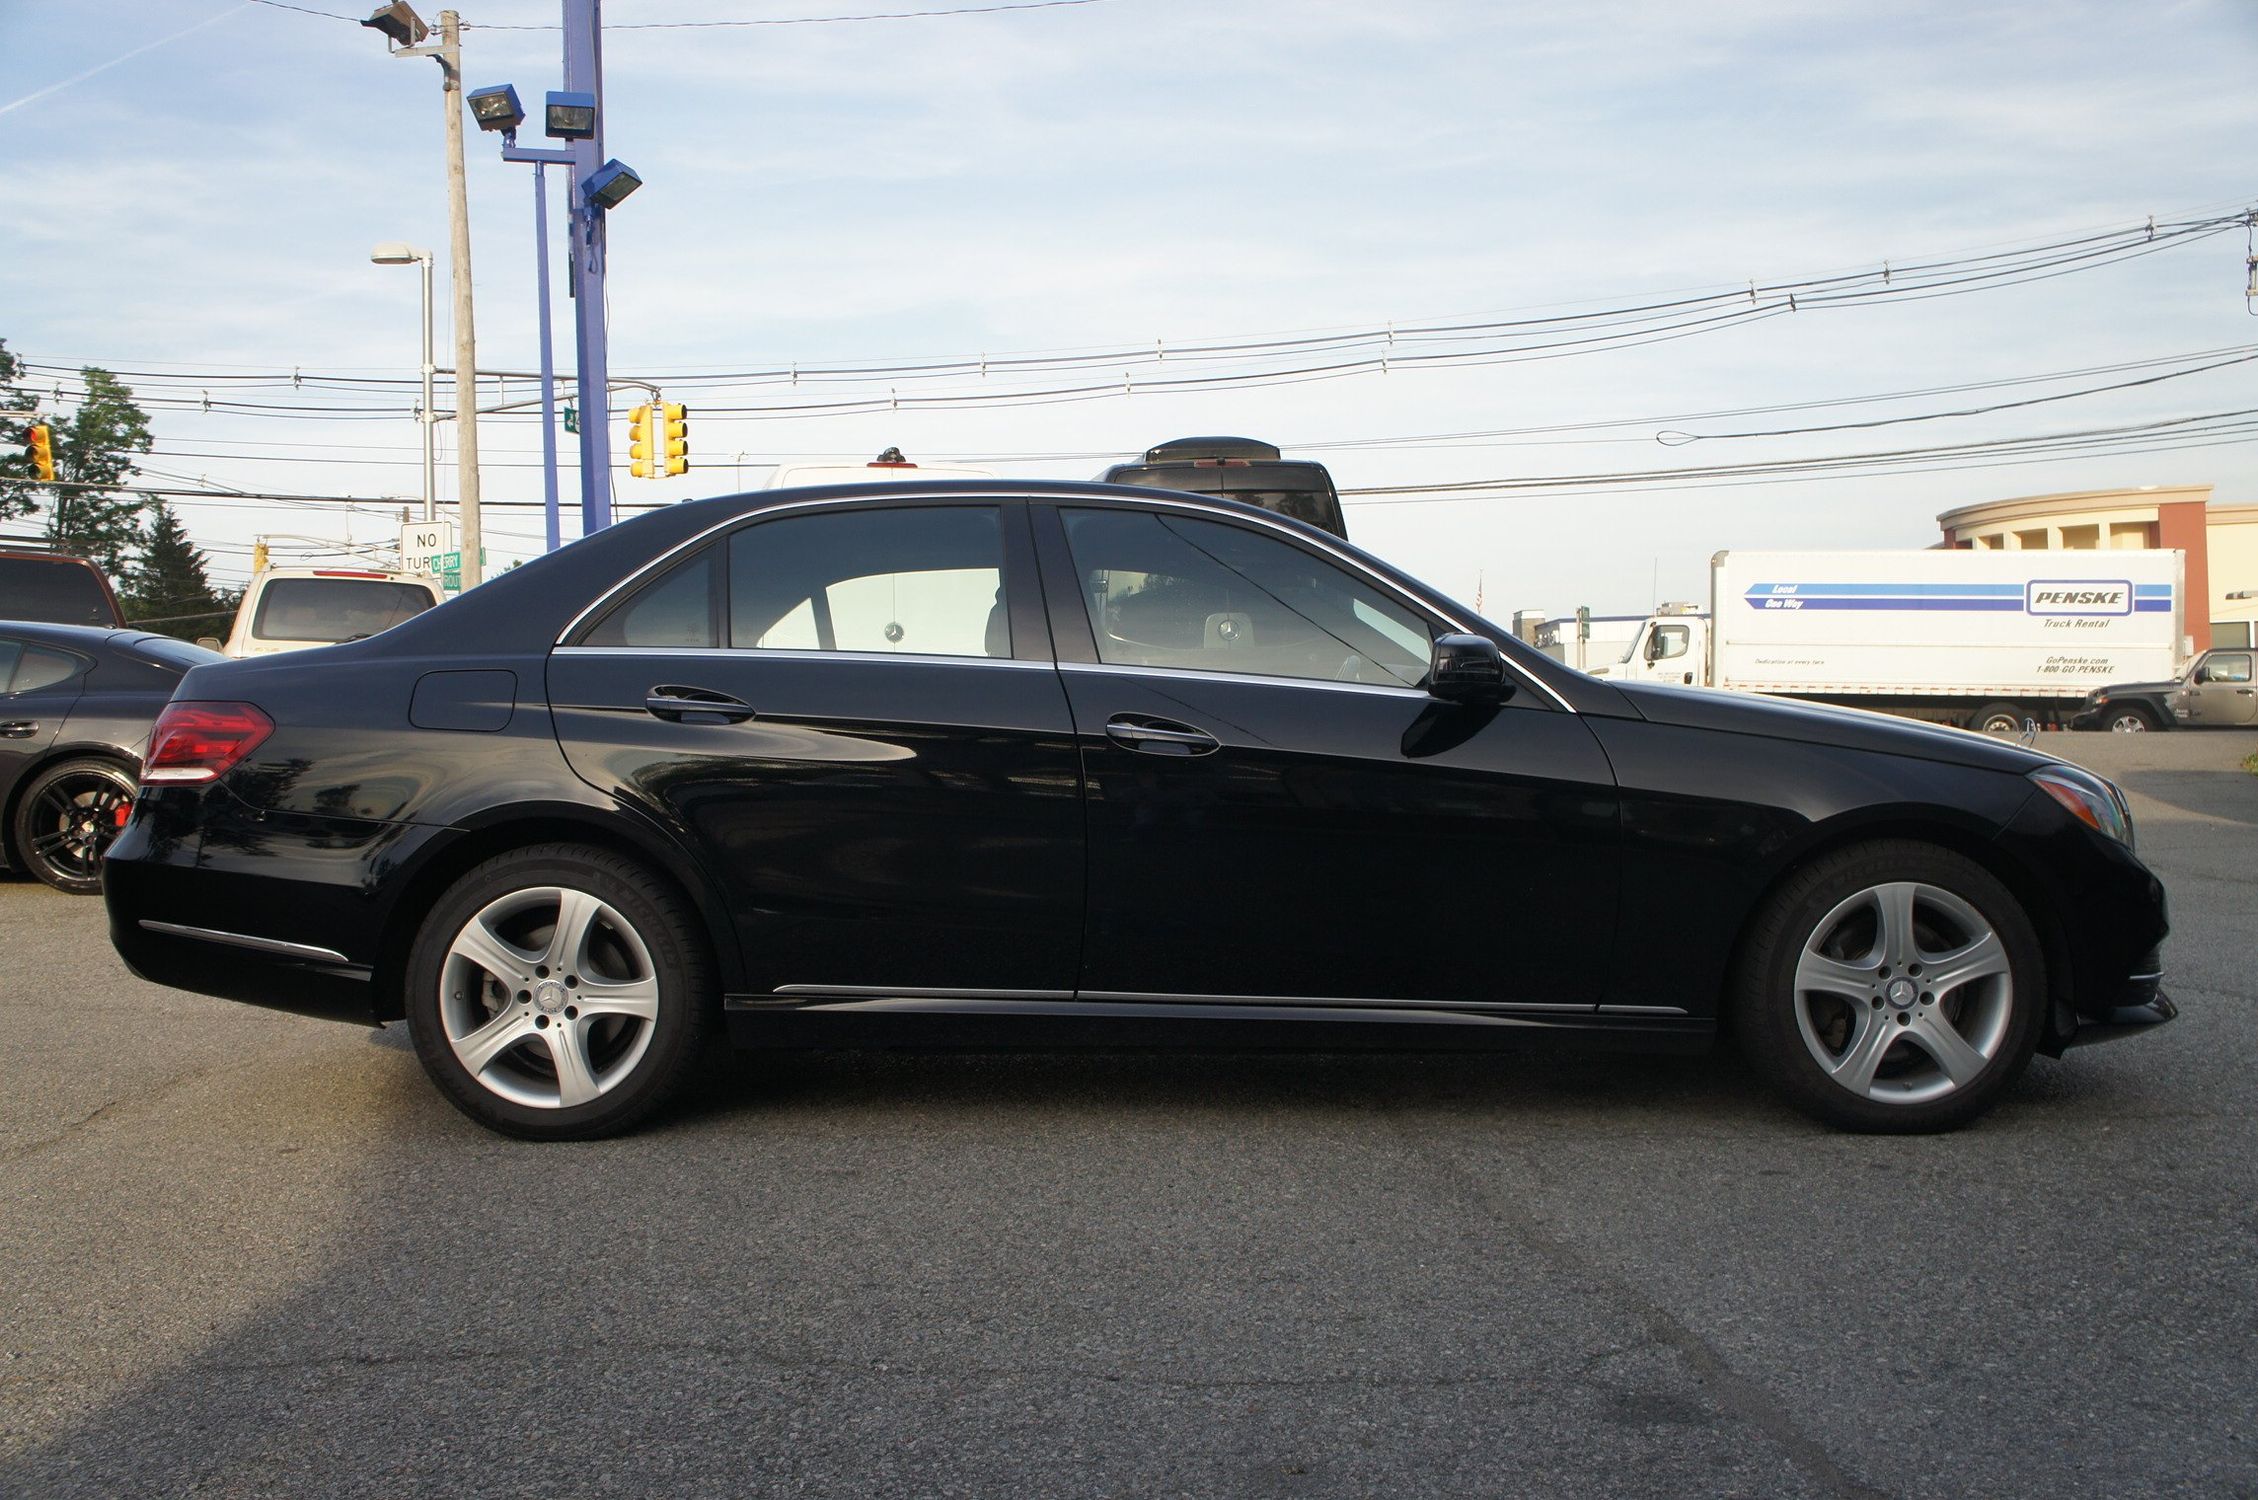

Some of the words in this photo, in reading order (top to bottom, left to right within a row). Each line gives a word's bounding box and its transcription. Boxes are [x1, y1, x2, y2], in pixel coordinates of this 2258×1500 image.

[417, 533, 437, 548] NO
[406, 556, 431, 569] TUR
[1771, 584, 1798, 594] Local
[2034, 591, 2125, 604] PENSKE
[1783, 598, 1804, 610] Way
[2043, 618, 2073, 628] Truck
[2074, 618, 2111, 628] Rental
[2045, 656, 2109, 665] GoPenske.com
